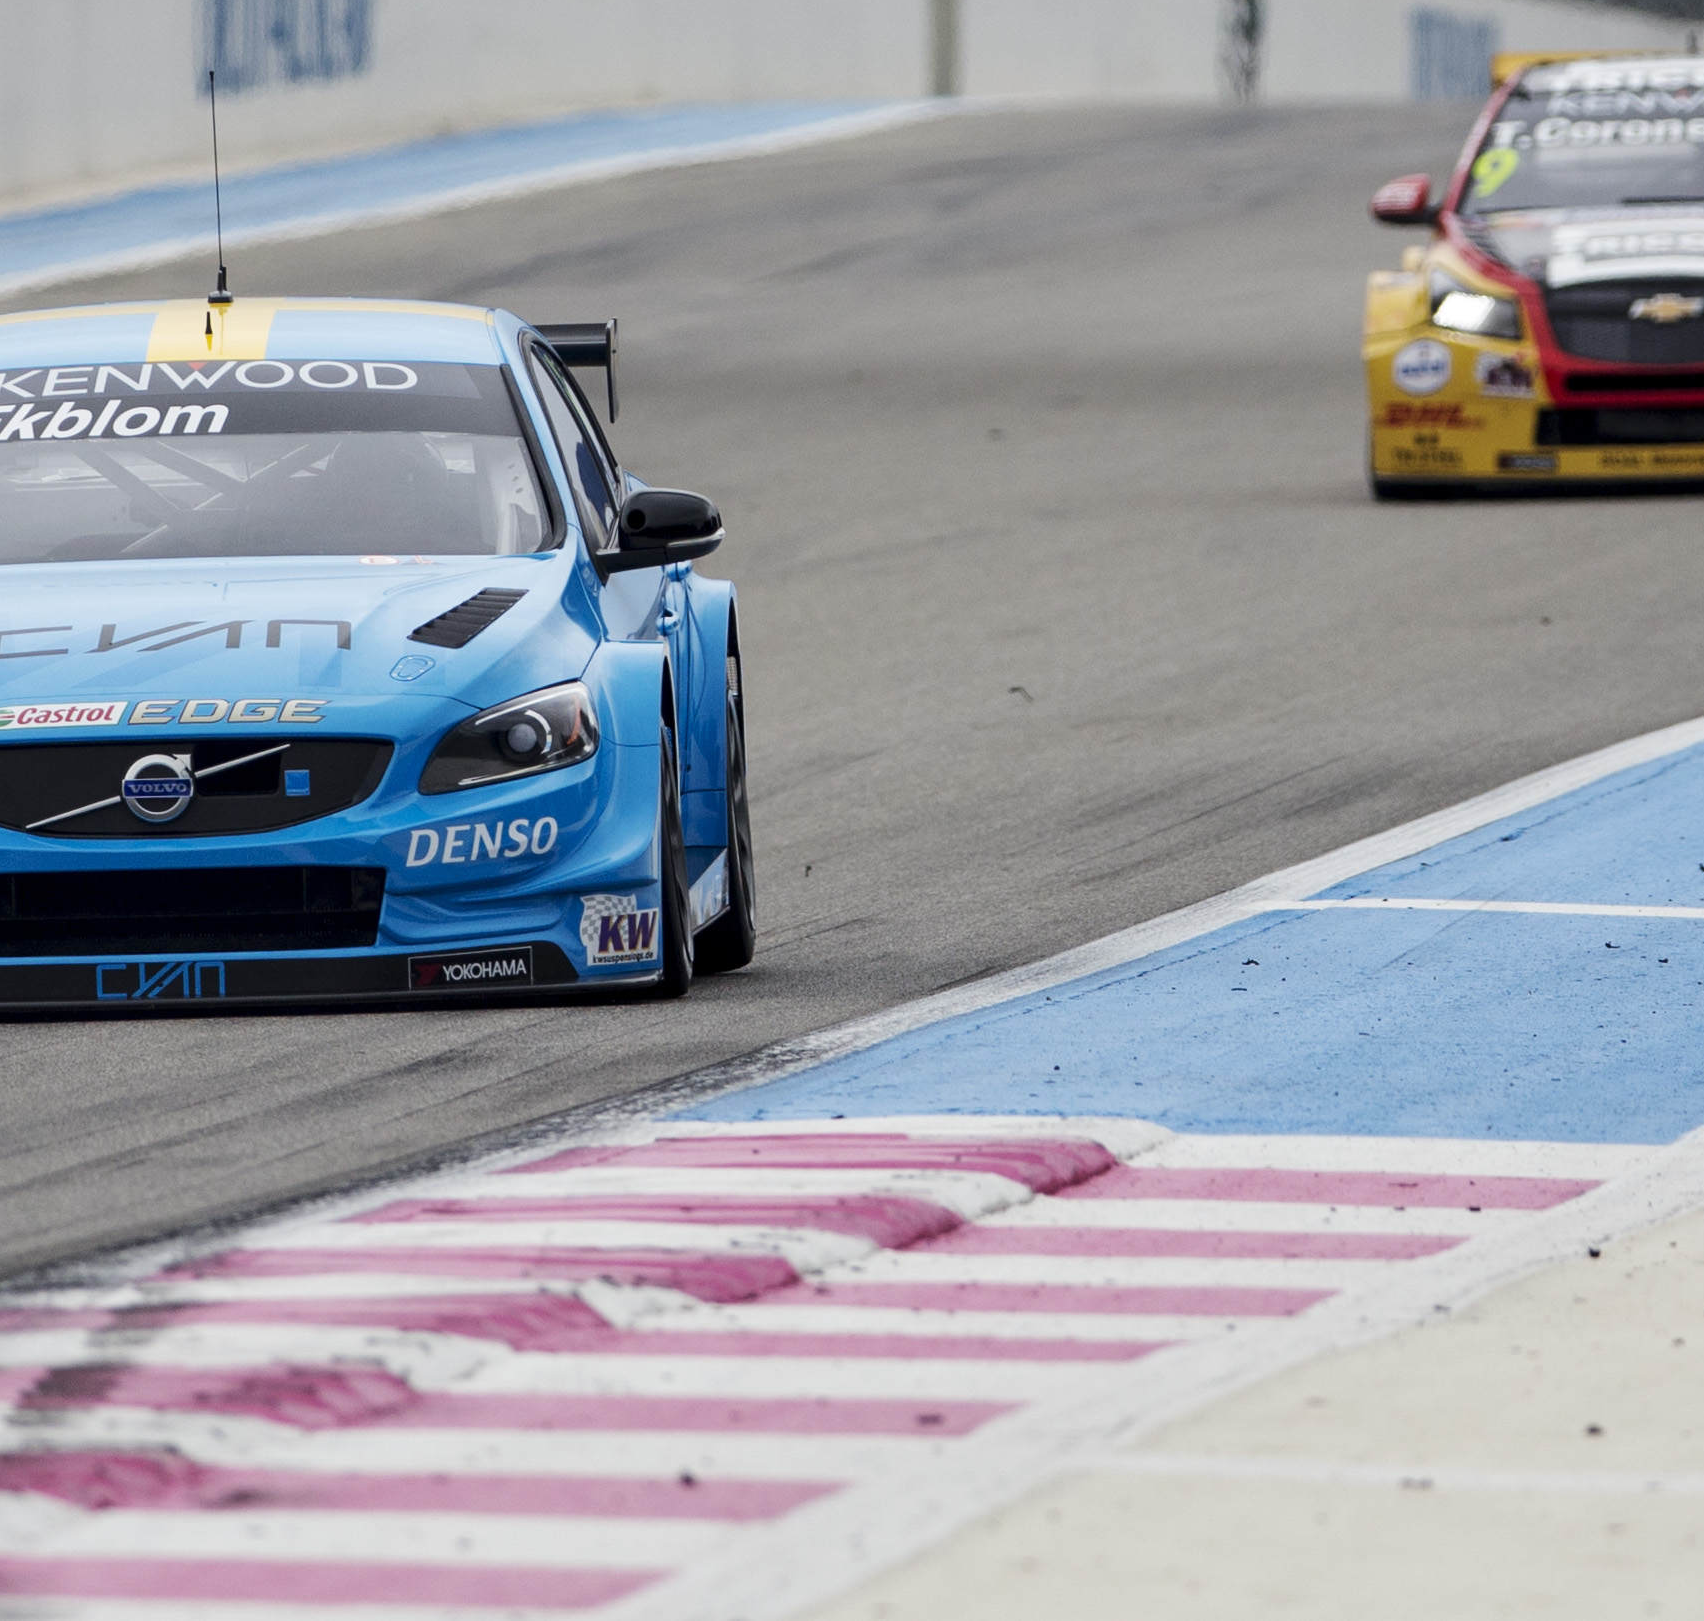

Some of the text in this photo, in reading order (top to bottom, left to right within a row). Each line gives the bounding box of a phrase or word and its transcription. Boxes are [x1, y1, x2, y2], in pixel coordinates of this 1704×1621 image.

[1472, 147, 1519, 198] 9
[17, 698, 331, 725] Castrol EDGE
[128, 782, 188, 794] VOLVO
[405, 816, 559, 868] DENSO
[598, 911, 657, 953] KW
[442, 958, 527, 981] YOKOHAMA
